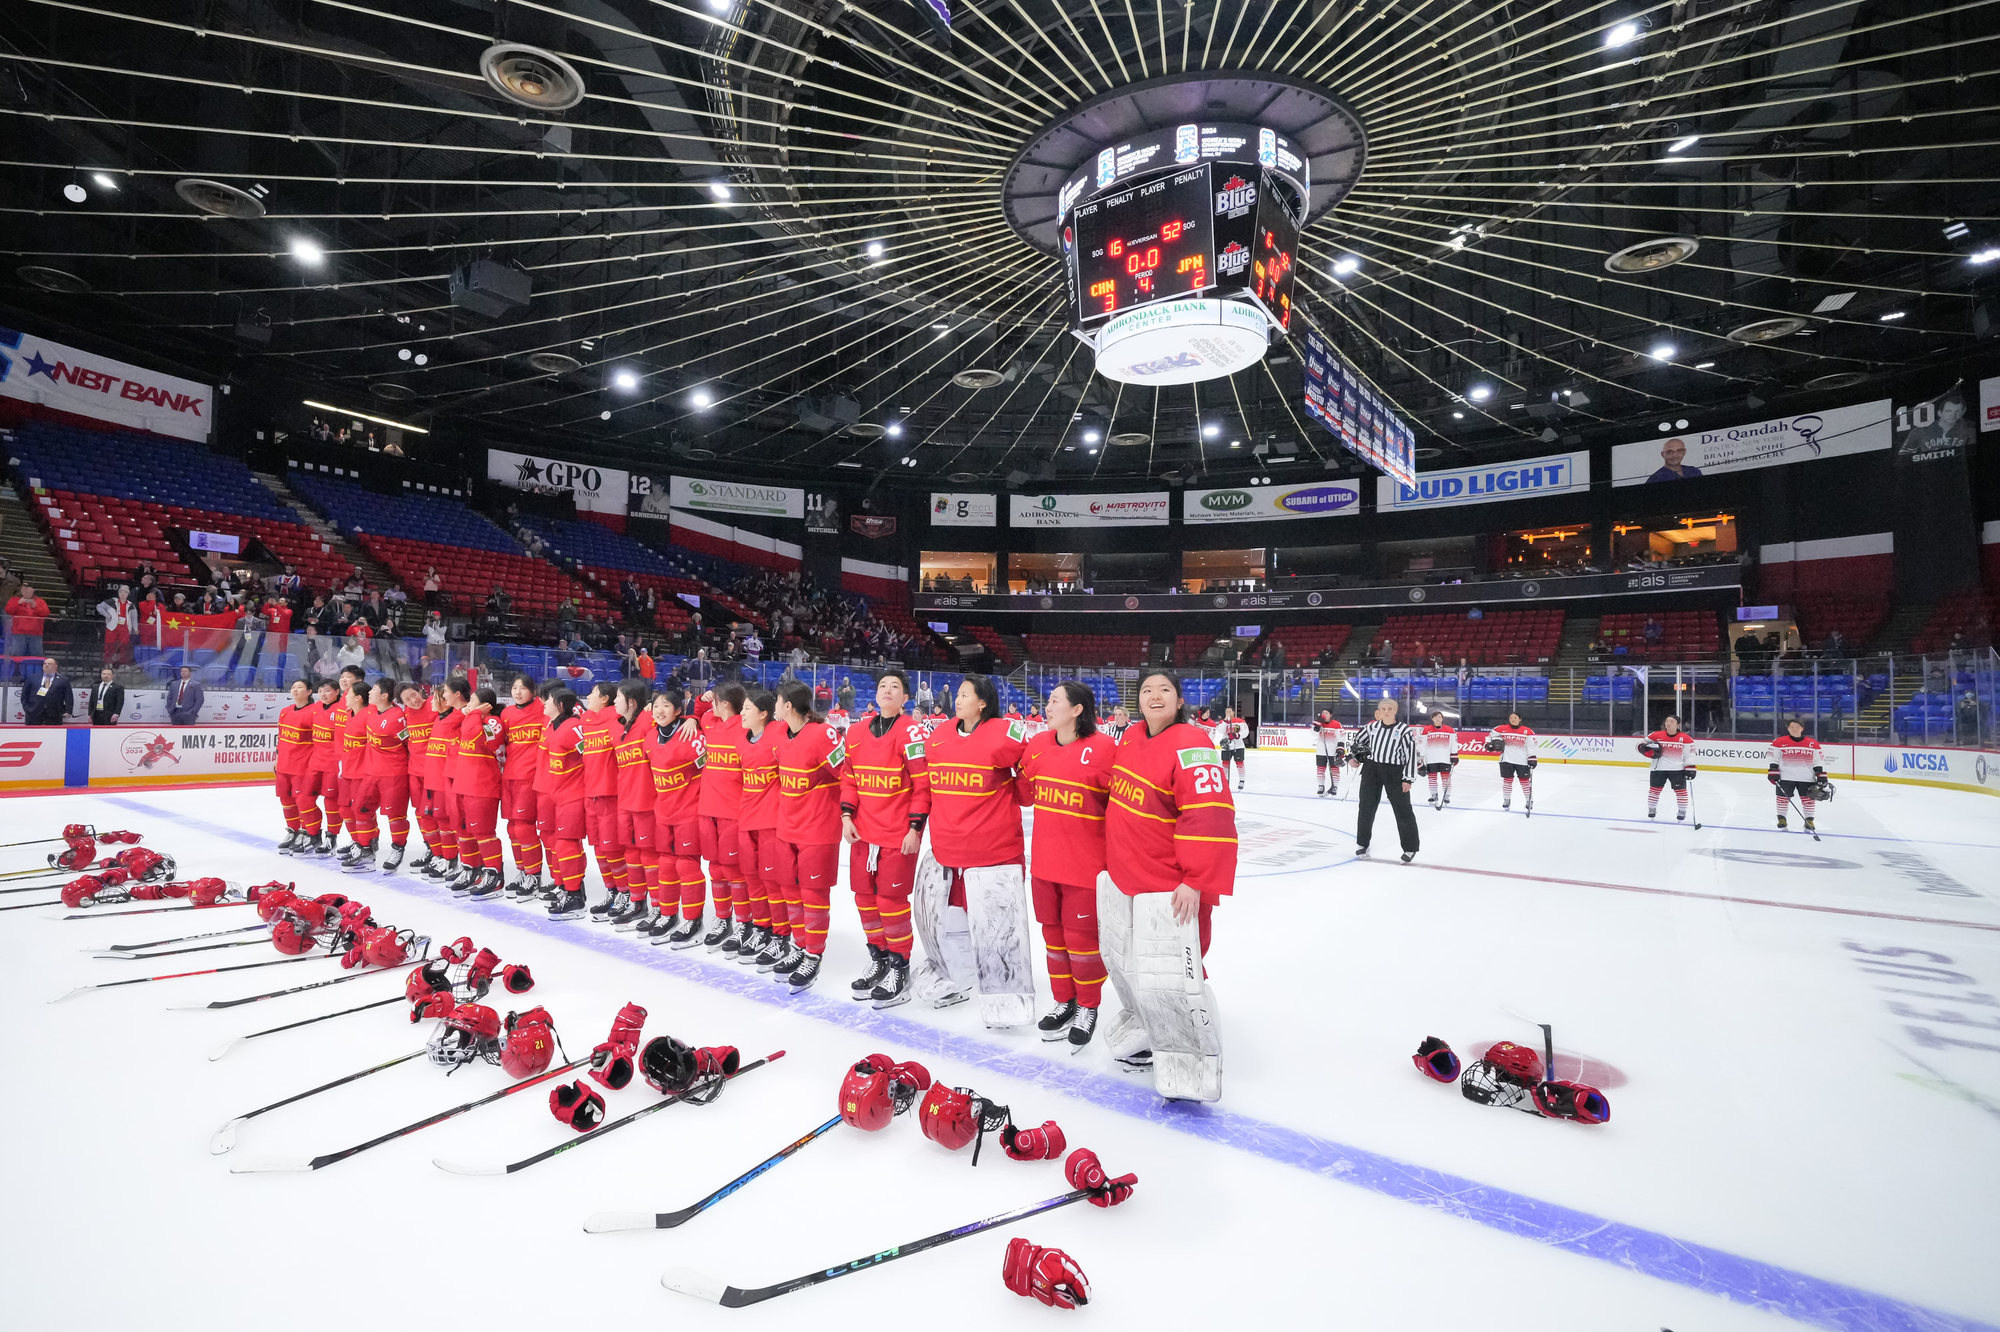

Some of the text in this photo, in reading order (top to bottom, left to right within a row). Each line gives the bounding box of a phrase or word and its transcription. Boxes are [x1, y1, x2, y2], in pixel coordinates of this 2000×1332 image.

[1075, 205, 1098, 218] PLAYER
[1106, 192, 1134, 208] PENALTY
[1141, 182, 1166, 197] PLAYER
[1174, 169, 1204, 185] PENALTY
[1215, 187, 1257, 215] Blue
[1163, 220, 1196, 241] 52 SOG
[1092, 240, 1122, 258] SOG 16
[1128, 248, 1159, 273] 0.0
[1176, 255, 1203, 274] JPN
[1216, 249, 1250, 273] Blue
[1065, 254, 1077, 309] pepsi
[1134, 269, 1153, 280] PERIOD
[1194, 269, 1205, 288] 2
[1090, 280, 1115, 297] CHN
[1140, 278, 1149, 291] 4
[1105, 293, 1115, 312] 3
[1106, 302, 1207, 335] ADIRONDACK BANK
[1128, 315, 1173, 332] CENTER
[52, 360, 205, 417] NBT BANK
[1895, 401, 1935, 433] 10
[1701, 421, 1789, 445] Dr. Qandah
[1703, 450, 1734, 460] BRAIN
[1756, 443, 1785, 452] SPINE
[1911, 449, 1955, 462] SMITH
[545, 462, 602, 492] GPO
[630, 475, 651, 495] 12
[1400, 463, 1565, 502] BUD LIGHT
[578, 489, 600, 498] UNION
[708, 483, 787, 502] STANDARD
[1208, 494, 1245, 506] MVM
[1285, 492, 1353, 506] SUBARU of UTICA
[807, 493, 823, 511] 11
[1106, 501, 1167, 509] MASTROVITO
[630, 511, 668, 520] BANNERMAN
[807, 526, 839, 534] MITCHELL
[1641, 573, 1665, 587] ais
[943, 596, 958, 606] ais
[1250, 594, 1267, 606] ais
[330, 712, 335, 721] A
[380, 719, 387, 729] A
[487, 718, 503, 735] 98
[906, 723, 931, 741] 23
[1259, 728, 1279, 736] COMING
[181, 734, 208, 750] MAY
[208, 734, 216, 749] 4
[224, 734, 238, 750] 12,
[239, 734, 266, 749] 2024
[1569, 737, 1615, 747] WYNN
[616, 747, 643, 762] HINA
[707, 751, 739, 764] HINA
[1080, 746, 1093, 765] C
[1695, 748, 1768, 760] HOCKEY.COM
[1901, 753, 1949, 771] NCSA
[654, 772, 685, 787] HINA
[743, 770, 778, 785] HINA
[854, 773, 902, 789] CHINA
[929, 771, 984, 788] CHINA
[1193, 766, 1223, 794] 29
[825, 1245, 900, 1278] CCM
